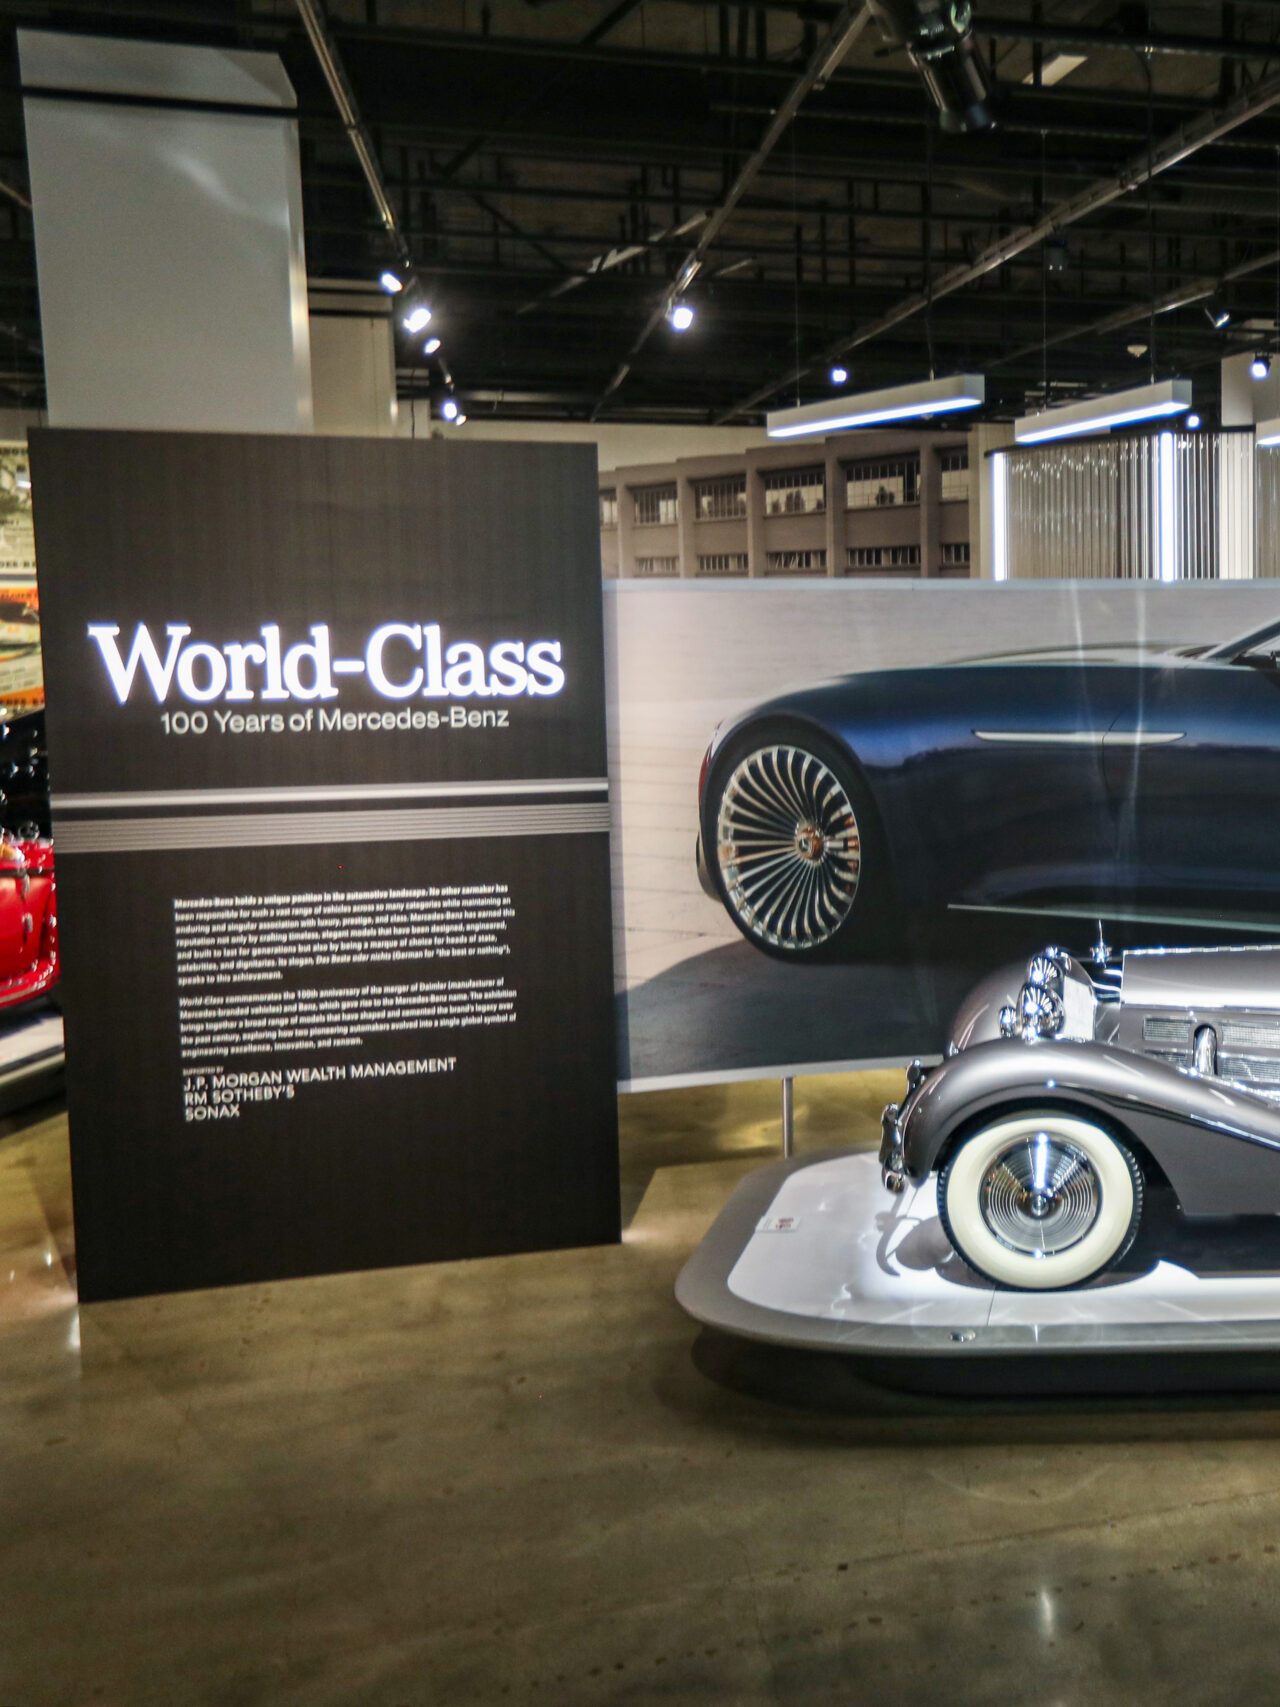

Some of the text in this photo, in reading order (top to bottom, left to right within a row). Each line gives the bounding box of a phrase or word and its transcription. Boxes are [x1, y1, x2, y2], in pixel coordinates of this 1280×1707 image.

[88, 621, 567, 705] World-Class
[161, 706, 510, 736] 100 Years of Mercedes-Benz
[184, 1057, 456, 1091] J.P. MORGAN WEALTH MANAGEMENT
[184, 1084, 295, 1106] RM SOTHEBY'S
[185, 1104, 240, 1122] SONAX
